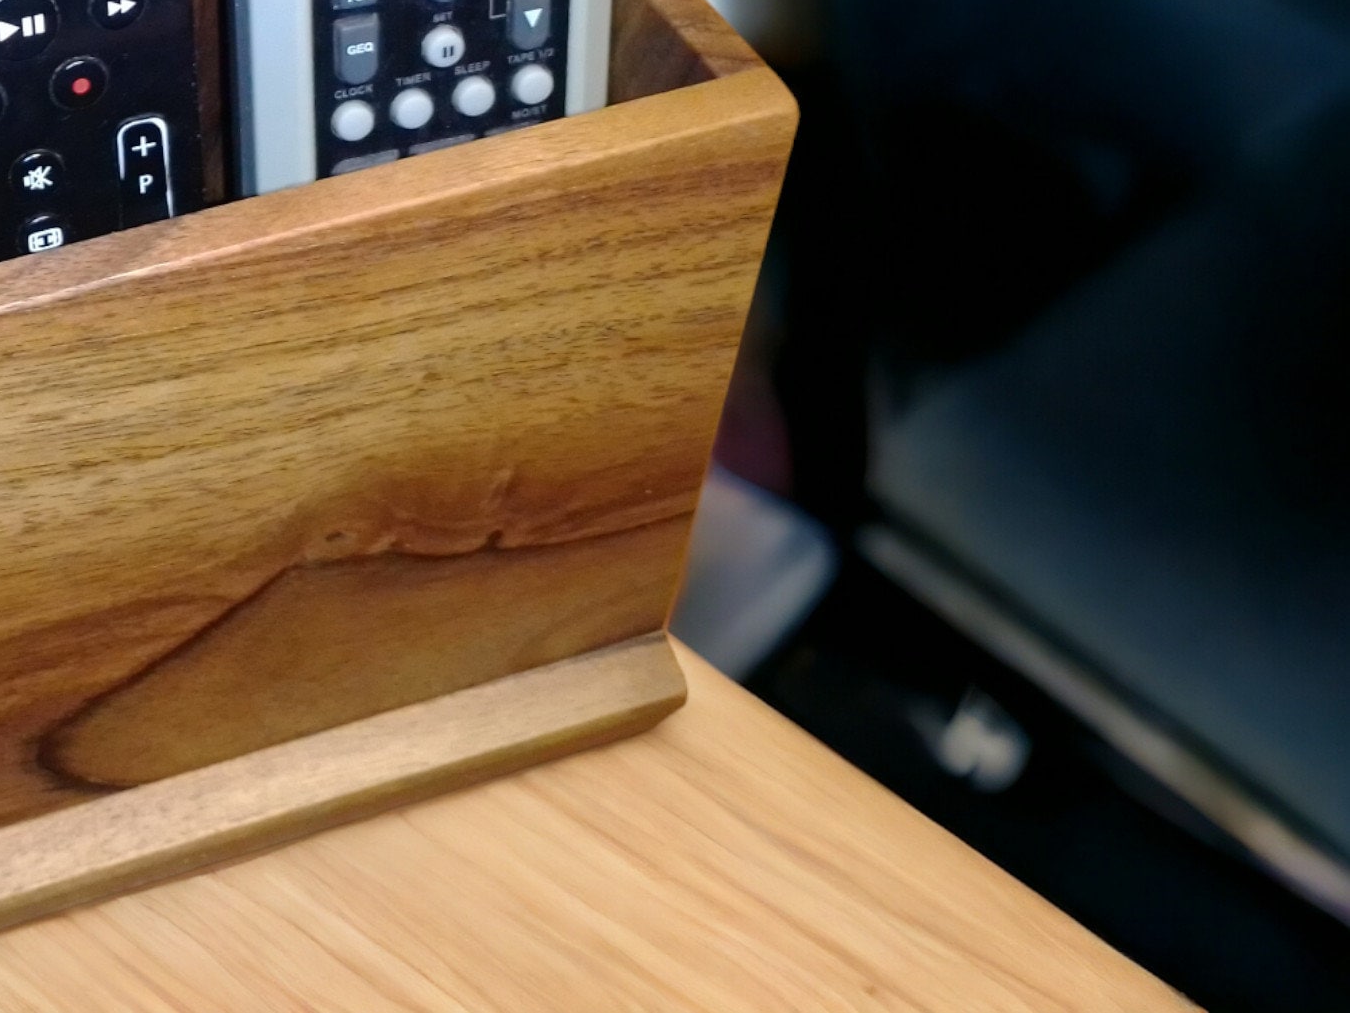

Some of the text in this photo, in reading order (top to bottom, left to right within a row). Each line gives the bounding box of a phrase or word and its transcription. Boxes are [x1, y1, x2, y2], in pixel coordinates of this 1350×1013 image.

[347, 41, 374, 55] GEQ
[454, 60, 491, 76] SLEEP
[334, 84, 374, 100] CLOCK
[139, 175, 153, 194] P
